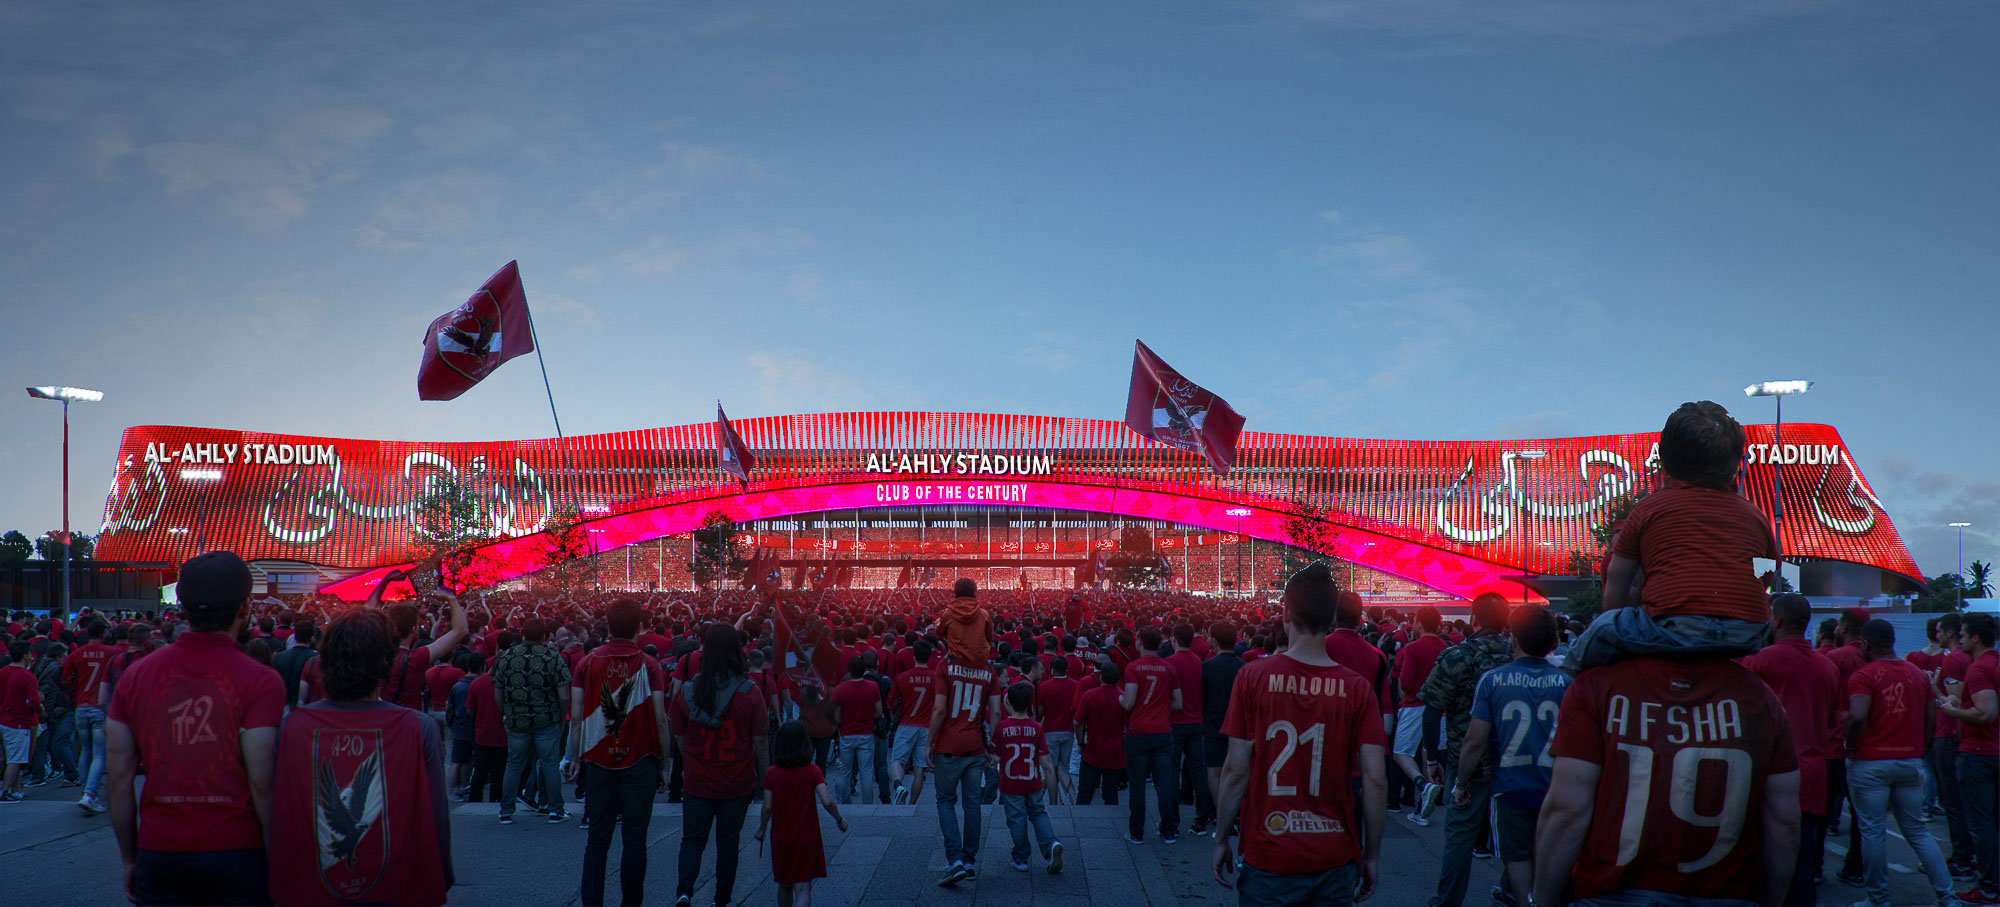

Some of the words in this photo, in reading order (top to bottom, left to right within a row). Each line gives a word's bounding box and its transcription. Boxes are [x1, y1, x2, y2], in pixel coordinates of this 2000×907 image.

[143, 441, 239, 464] AL-AHLY
[243, 444, 335, 465] STADIUM
[866, 453, 952, 474] AL-AHLY
[956, 454, 1052, 475] STADIUM
[1747, 443, 1839, 465] STADIUM
[876, 484, 910, 502] CLUB
[915, 485, 932, 500] OF
[936, 486, 963, 500] THE
[967, 484, 1028, 502] CENTURY
[84, 662, 101, 692] 7
[909, 675, 932, 684] AMIR
[1143, 675, 1158, 705] 7
[1268, 673, 1347, 698] MALOUL
[910, 686, 927, 717] 7
[951, 680, 983, 722] 14
[1500, 700, 1560, 768] 22
[1606, 694, 1743, 744] AFSHA
[1004, 743, 1036, 781] 23
[1265, 719, 1326, 797] 21
[1615, 742, 1753, 874] 19
